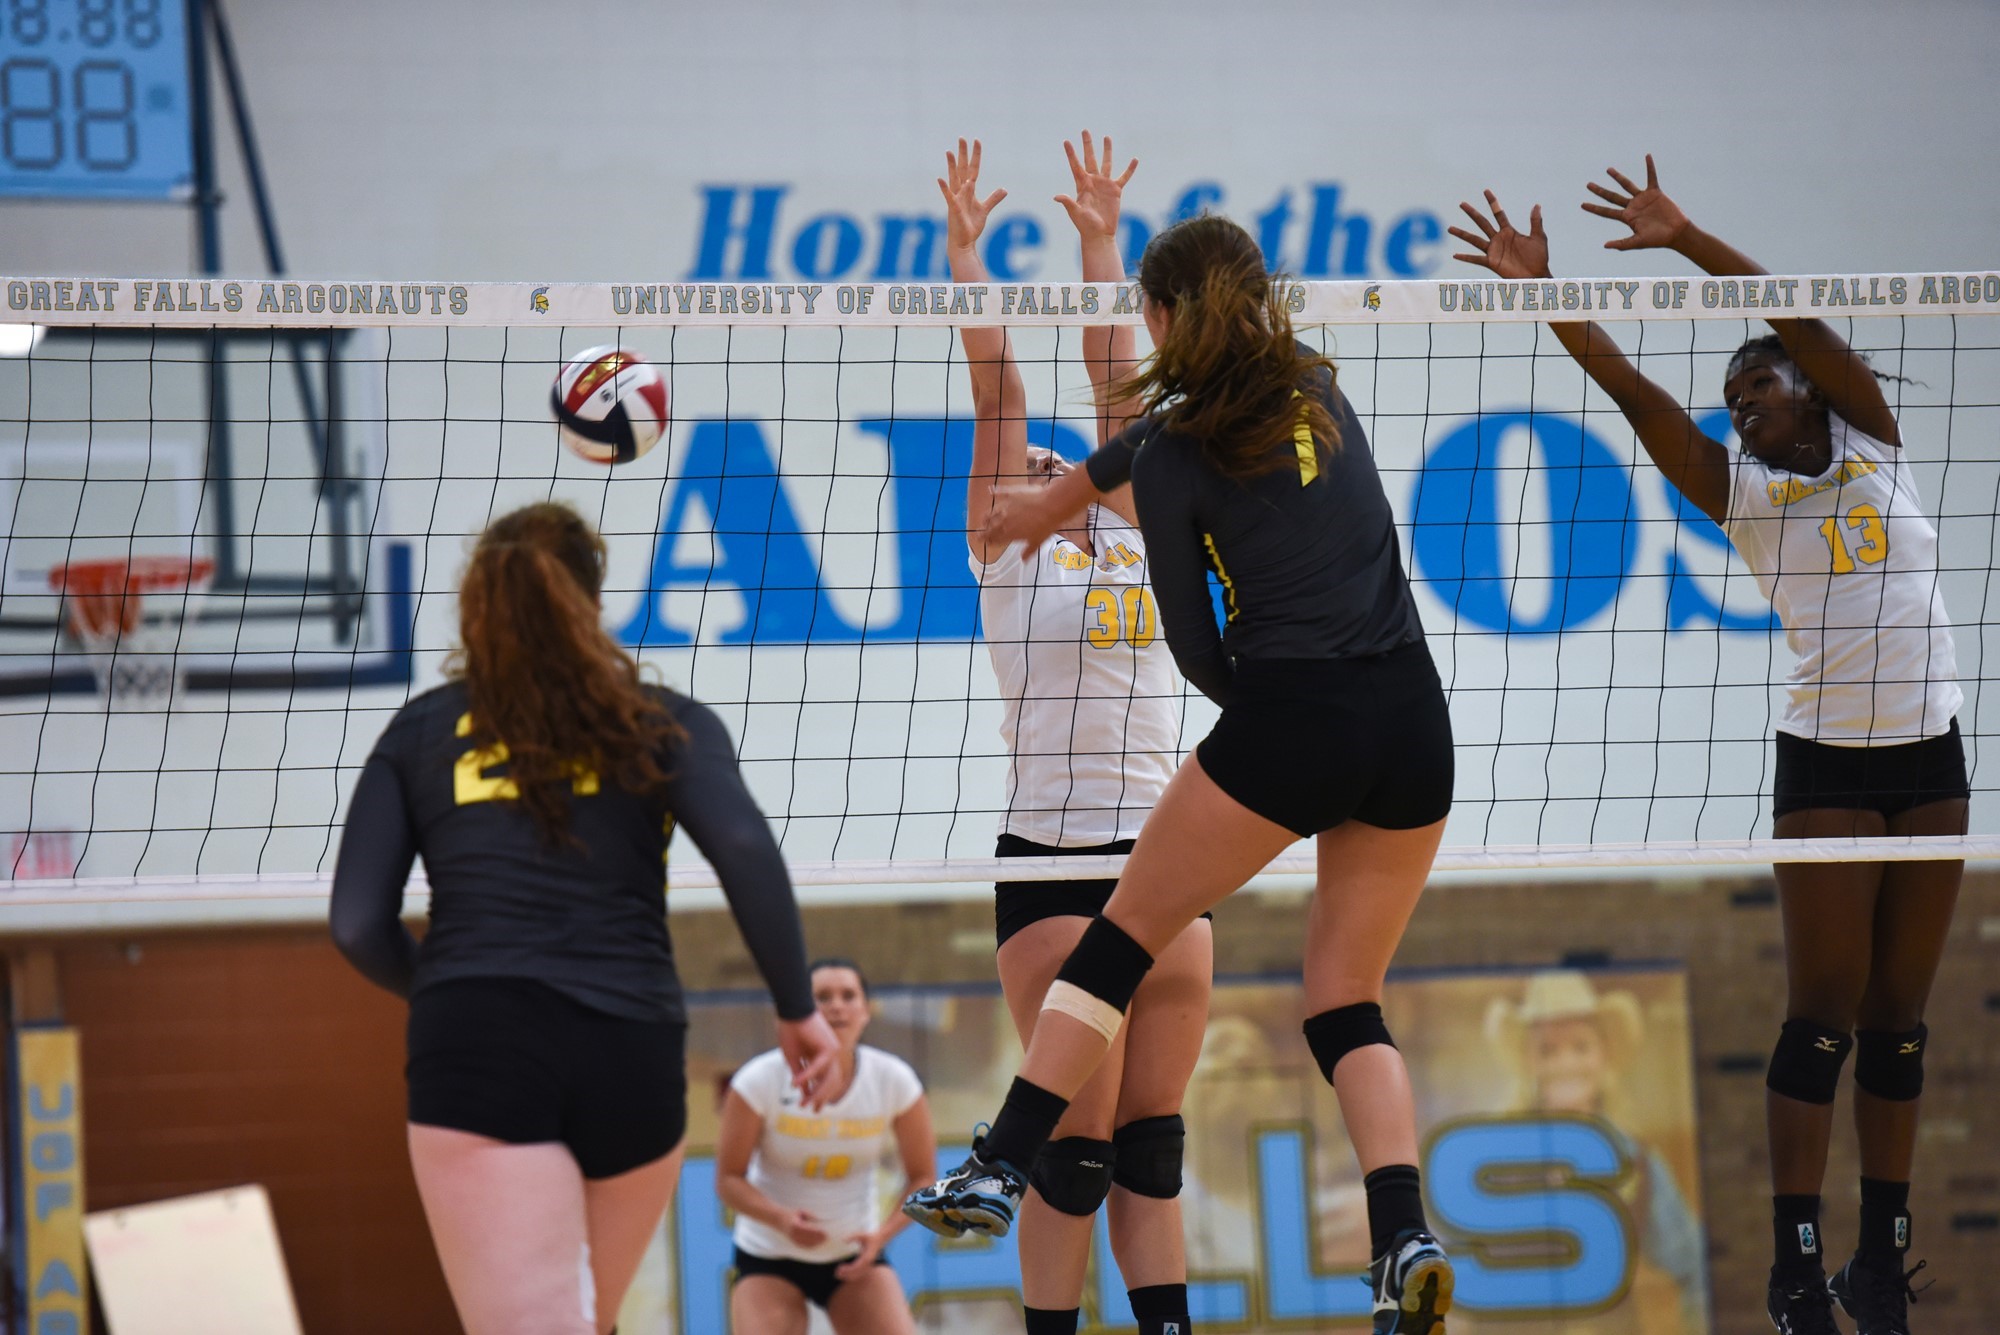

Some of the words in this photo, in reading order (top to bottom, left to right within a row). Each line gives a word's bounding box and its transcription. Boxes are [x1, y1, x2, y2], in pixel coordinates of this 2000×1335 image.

[684, 182, 1047, 283] Home
[8, 281, 119, 310] GREAT
[134, 282, 243, 312] FALLS
[257, 284, 468, 315] ARGONAUTS
[611, 286, 822, 314] UNIVERSITY
[836, 286, 874, 314] OF
[888, 286, 988, 314] GREAT
[1001, 286, 1099, 314] FALLS
[1439, 282, 1640, 311] UNIVERSITY
[1652, 281, 1689, 309] OF
[1701, 280, 1799, 308] GREAT
[1811, 277, 1907, 306] FALLS
[1919, 275, 2000, 304] ARGO
[1818, 503, 1891, 577] 13
[1086, 587, 1156, 649] 30
